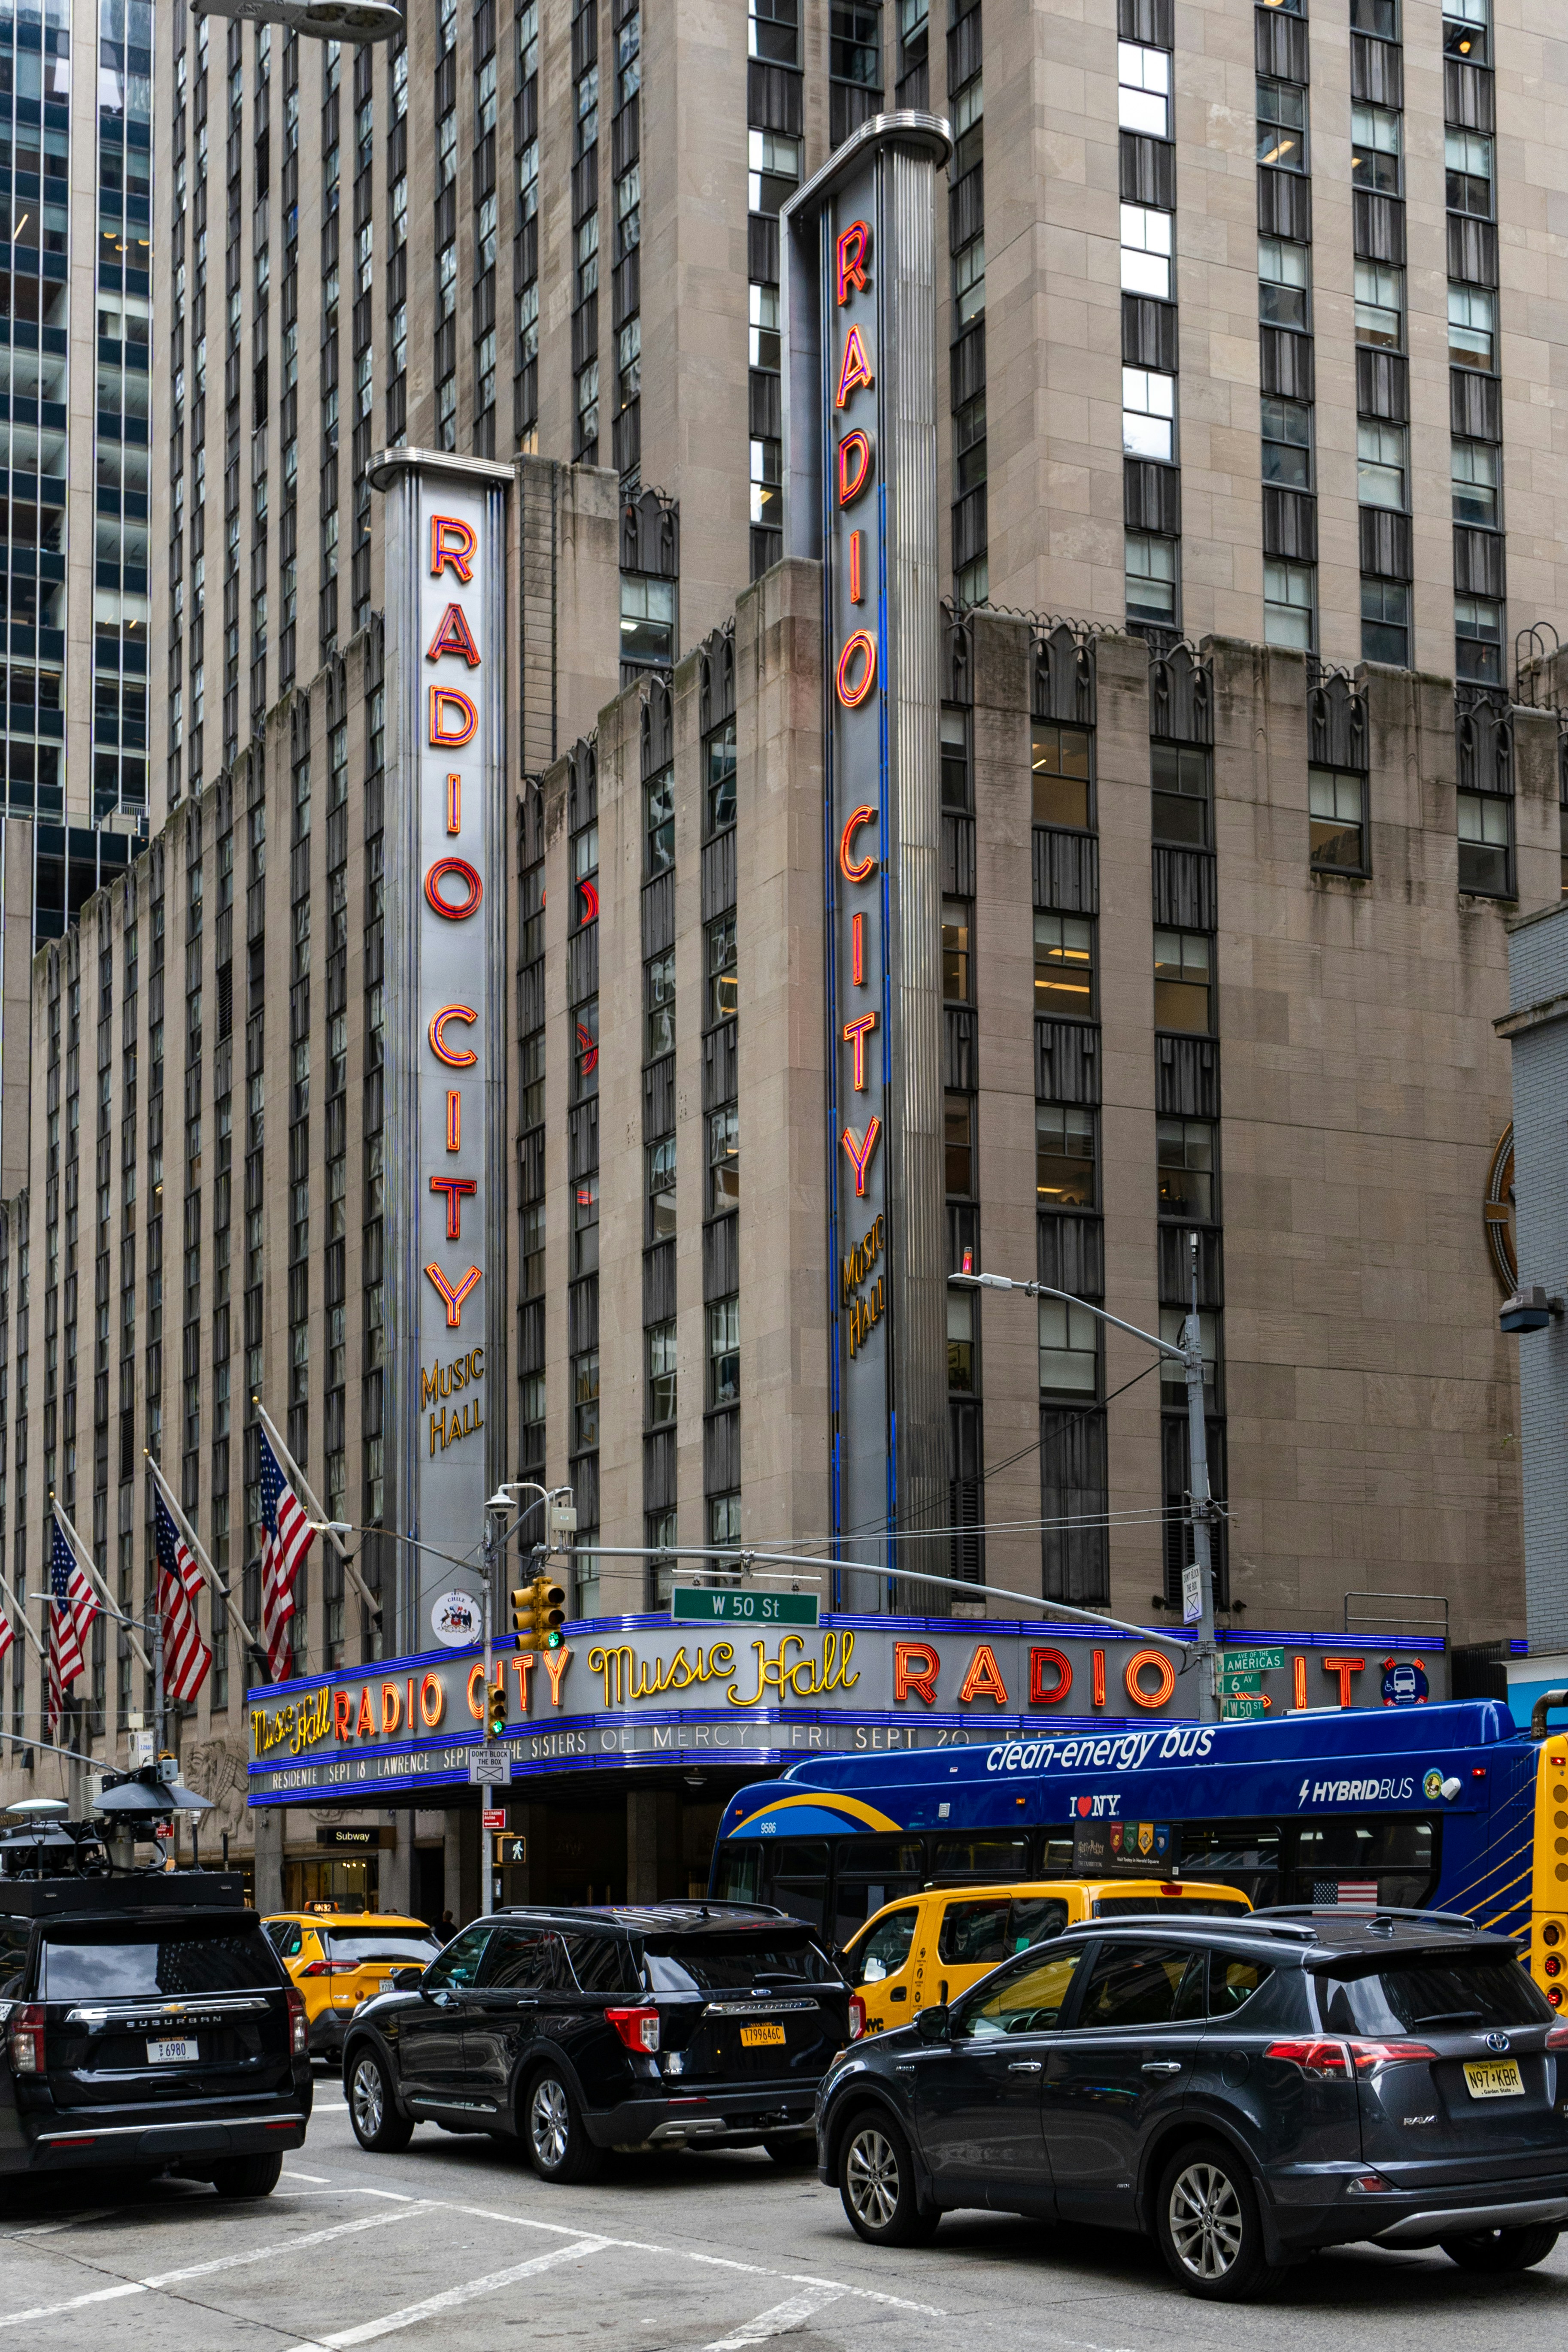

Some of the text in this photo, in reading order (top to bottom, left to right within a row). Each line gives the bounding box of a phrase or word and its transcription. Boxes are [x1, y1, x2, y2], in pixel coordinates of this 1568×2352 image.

[837, 220, 881, 1197] RADIO CITY
[425, 514, 483, 1327] RADIO CITY
[843, 1214, 884, 1308] MUSIC
[849, 1275, 884, 1359] HALL
[421, 1348, 485, 1412] MUSIC
[430, 1398, 484, 1457] HALL
[1191, 1568, 1200, 1577] BLOCK
[713, 1596, 779, 1618] W 50 St
[588, 1629, 861, 1708] Music Hall
[1227, 1655, 1281, 1671] AMERICAS
[893, 1641, 1175, 1709] RADIO
[1231, 1675, 1253, 1691] 6 AV
[334, 1672, 443, 1742] RADIO
[1230, 1701, 1262, 1717] W 50 ST
[250, 1685, 331, 1757] Music Hall
[273, 1767, 317, 1789] RESIDENTE
[329, 1763, 351, 1782] SEPT
[357, 1761, 366, 1779] 18
[377, 1752, 430, 1776] LAWRENCE
[531, 1731, 586, 1758] SISTERS
[601, 1729, 631, 1750] OF
[653, 1725, 749, 1748] MERCY
[855, 1727, 916, 1749] SEPT
[937, 1729, 969, 1746] 20
[986, 1726, 1216, 1771] clean-energy bus
[336, 1831, 370, 1842] Subway
[761, 1822, 776, 1834] 9586
[314, 1903, 332, 1912] 6N32
[127, 2016, 221, 2028] SUBURBAN
[866, 2017, 884, 2033] NYC
[744, 2027, 781, 2042] T799646C
[166, 2043, 186, 2057] 6980
[1403, 2115, 1438, 2126] RAV4
